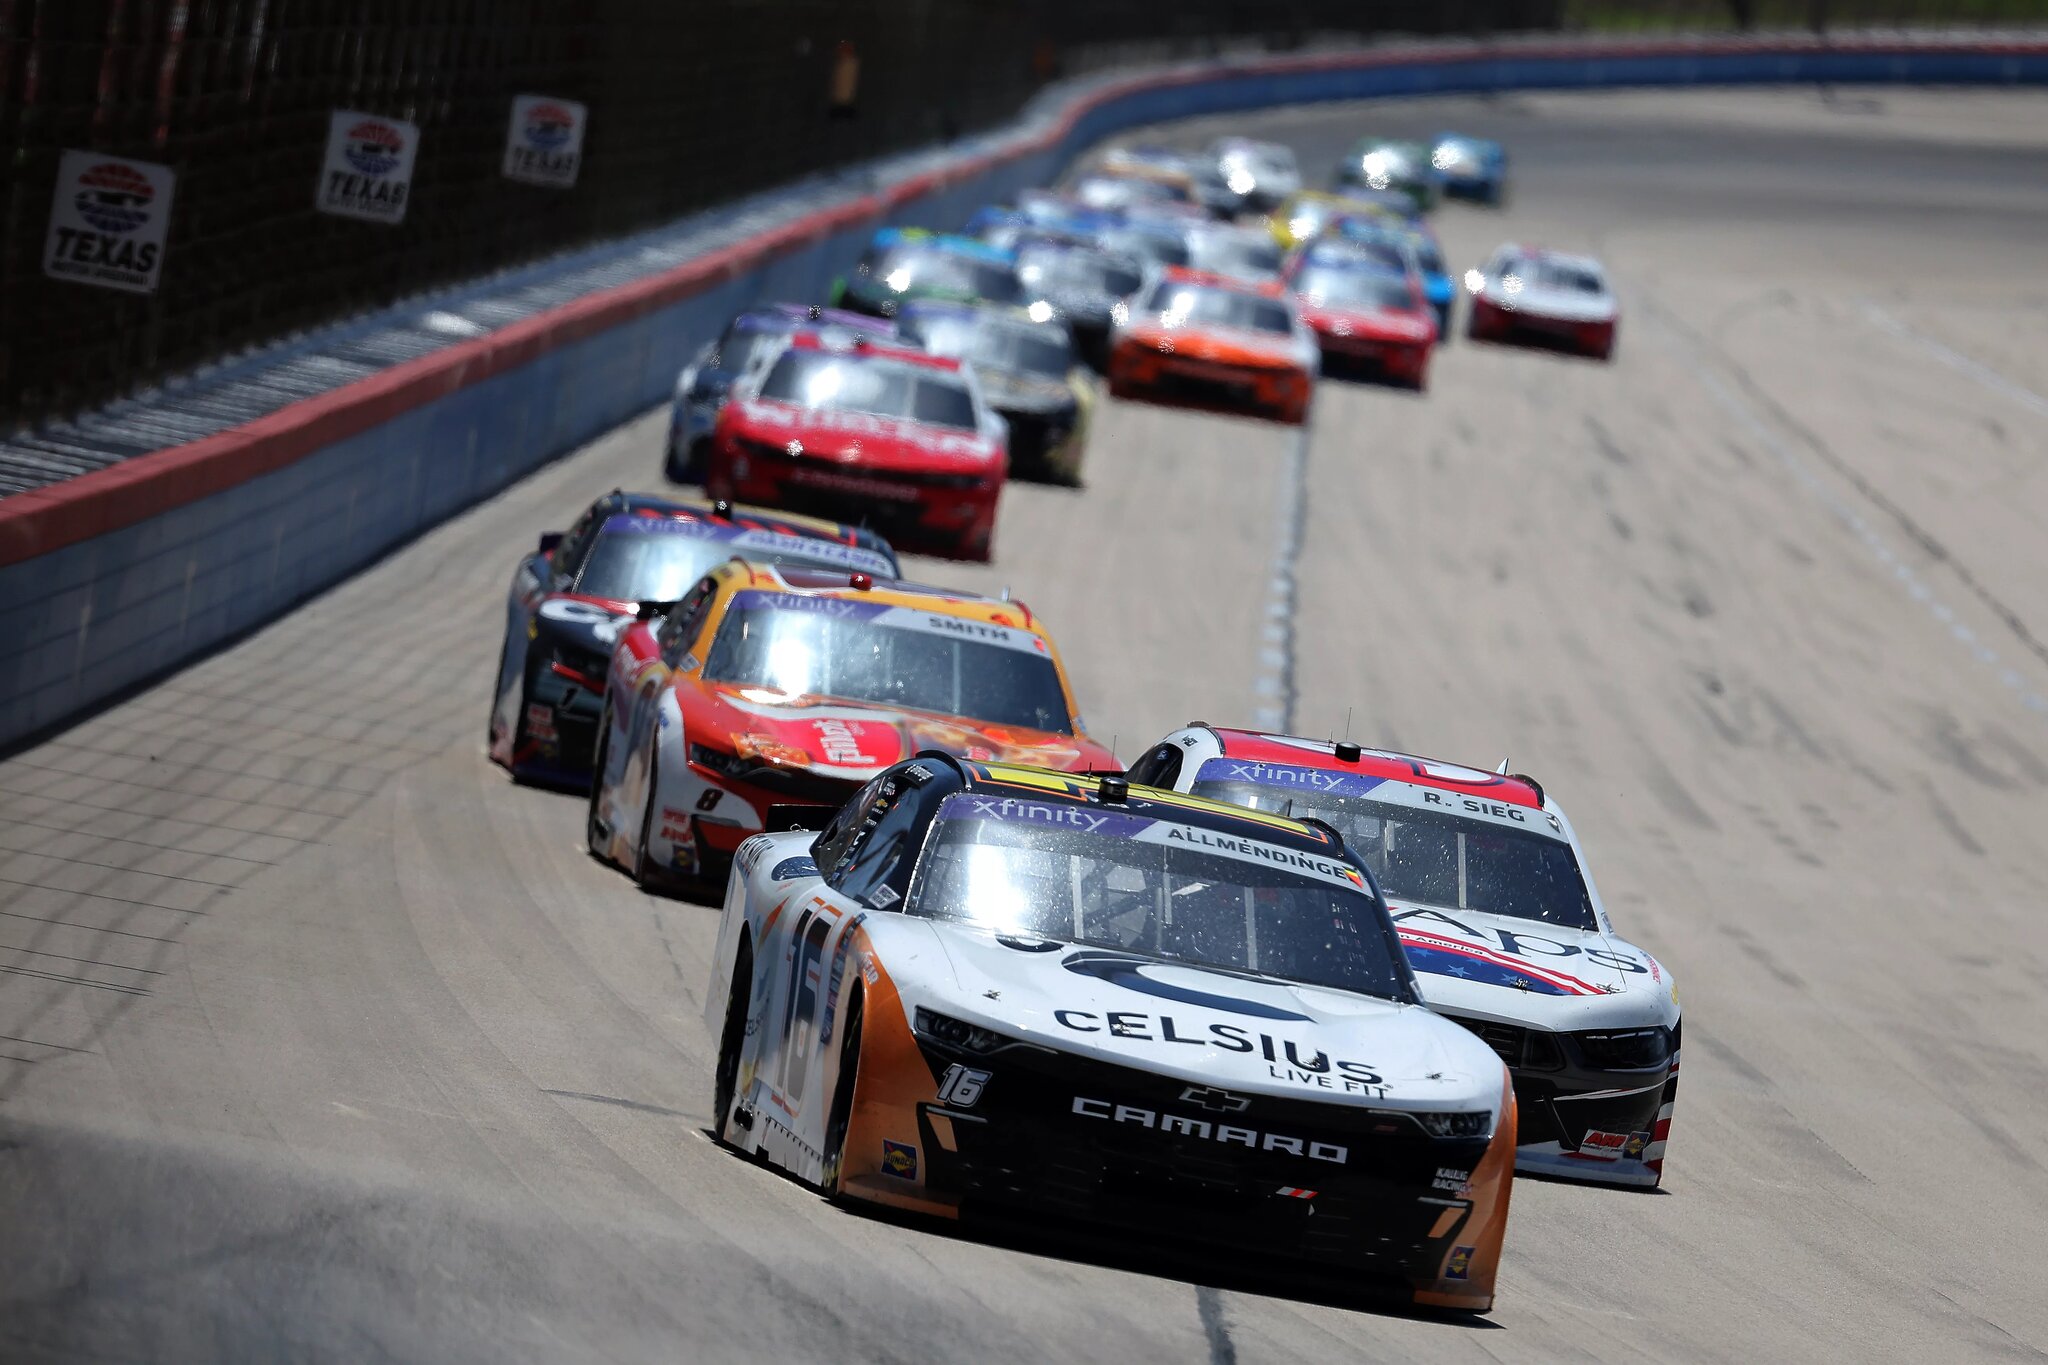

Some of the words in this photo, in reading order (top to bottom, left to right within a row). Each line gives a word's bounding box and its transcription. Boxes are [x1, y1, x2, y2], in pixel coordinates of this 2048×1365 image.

[329, 170, 407, 204] TEXAS
[55, 226, 158, 272] TEXAS
[629, 518, 718, 540] xfinity
[758, 592, 856, 618] xfinity
[928, 616, 1010, 641] SMITH
[1229, 763, 1345, 791] xfinity
[696, 788, 725, 811] 8
[973, 799, 1109, 832] xfinity
[1423, 791, 1452, 807] R.
[1464, 799, 1525, 823] SIEG
[1168, 828, 1352, 880] ALLMENDINGE
[1416, 936, 1484, 956] America
[1053, 1009, 1384, 1085] CELSIUS
[935, 1063, 993, 1108] 16
[1270, 1065, 1333, 1089] LIVE
[1346, 1080, 1389, 1101] FIT
[1071, 1096, 1348, 1164] CAMARO
